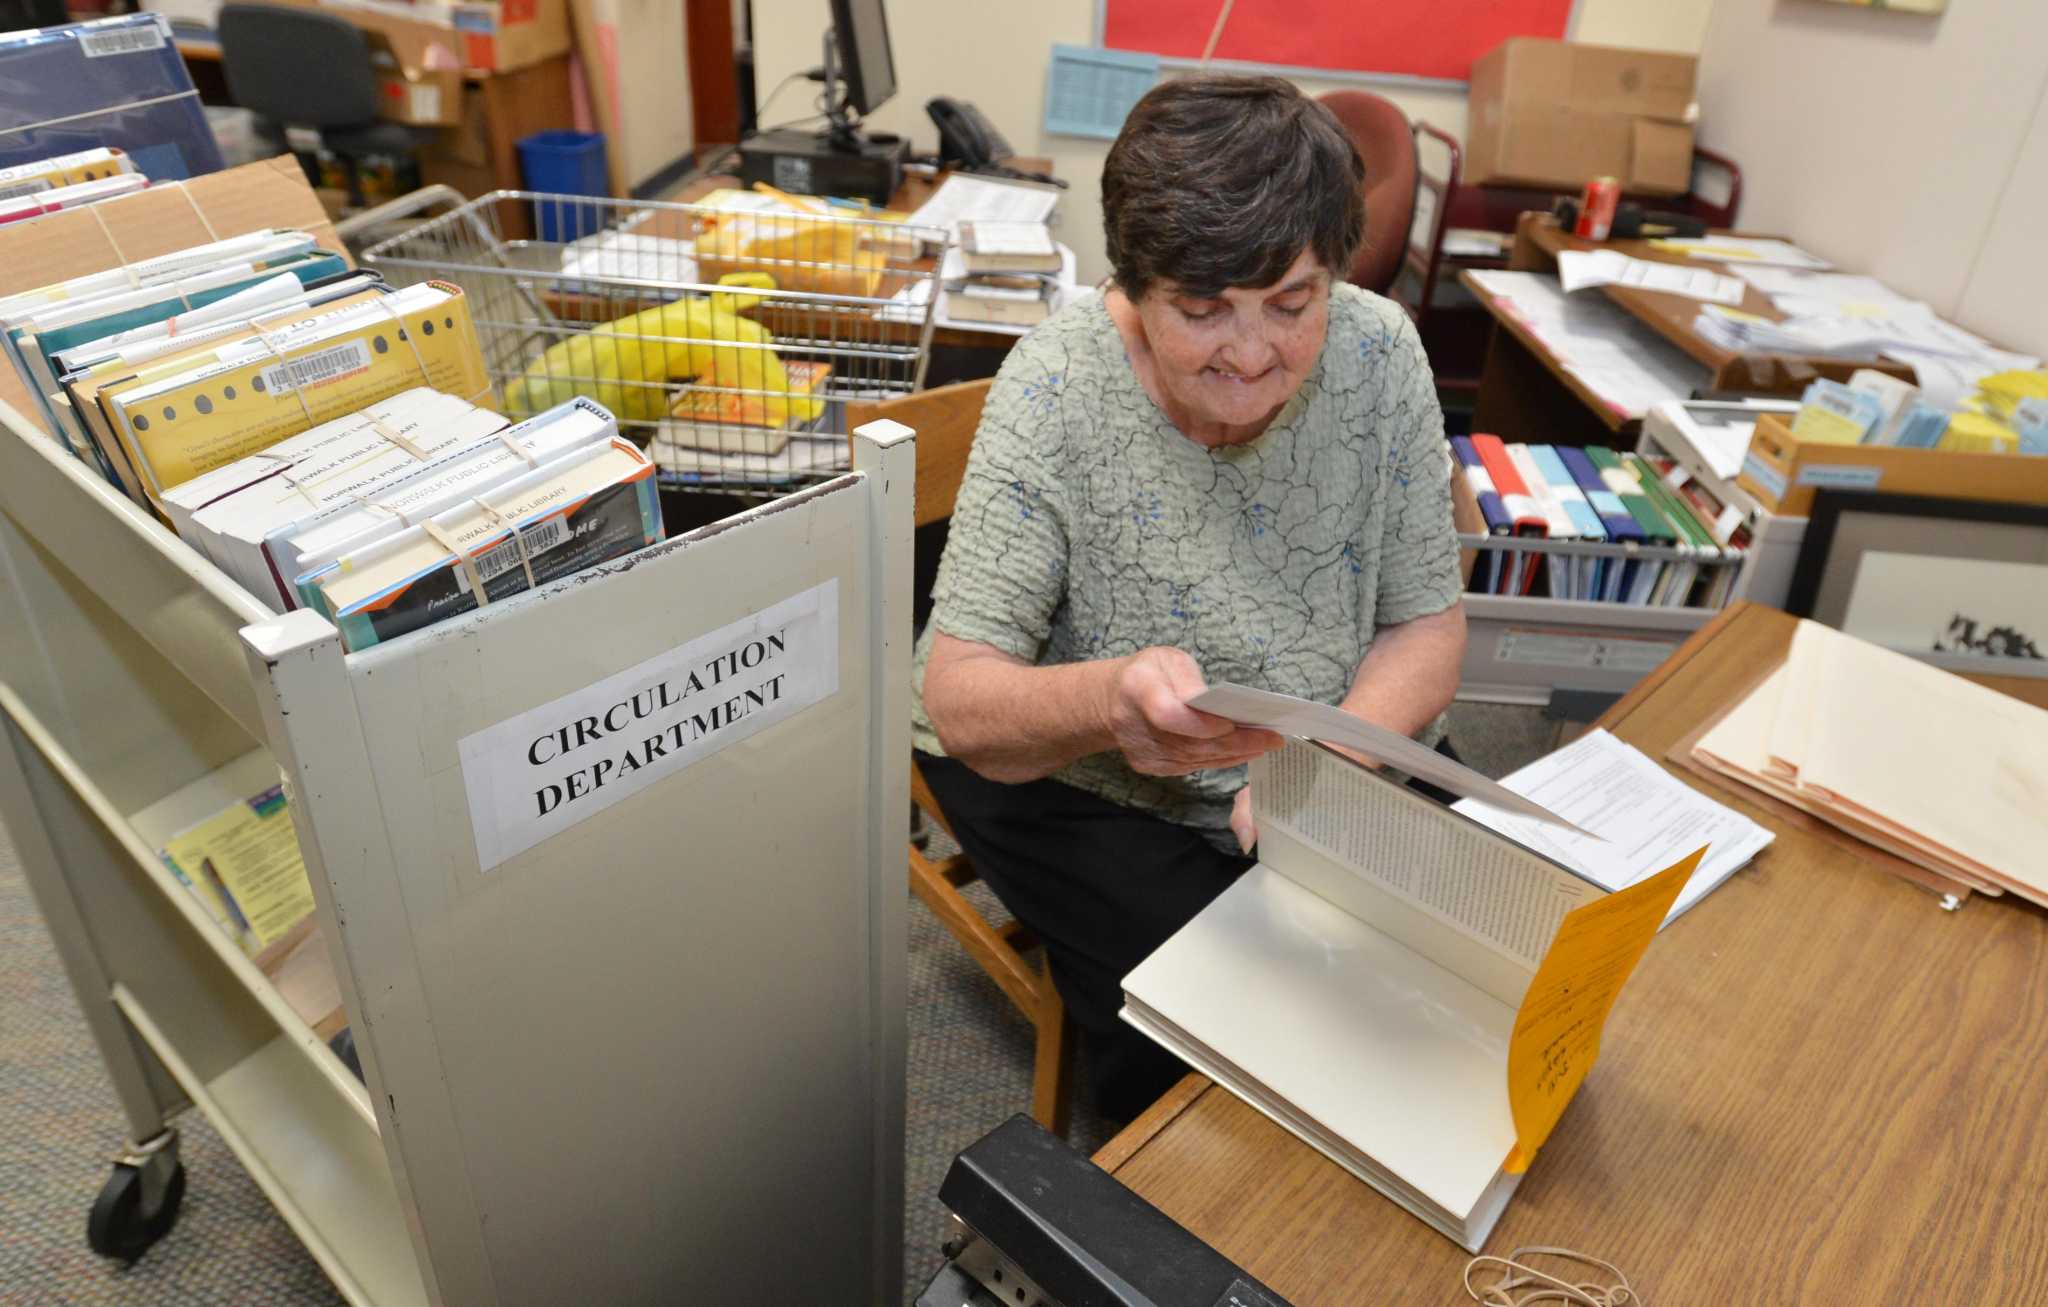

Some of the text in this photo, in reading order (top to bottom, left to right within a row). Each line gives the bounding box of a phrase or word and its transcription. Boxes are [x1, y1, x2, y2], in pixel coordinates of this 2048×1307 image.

[260, 411, 392, 474] NORALK PUBLIC LIBRRY
[285, 462, 340, 490] NRWALK
[339, 443, 379, 464] PUBLIC
[321, 476, 381, 502] NORWALK
[445, 461, 489, 484] PUBLIC
[456, 485, 567, 544] RWALK PBLIC LIBRARY
[527, 629, 787, 766] CIRCULATION
[535, 674, 786, 818] DEPARTMENT
